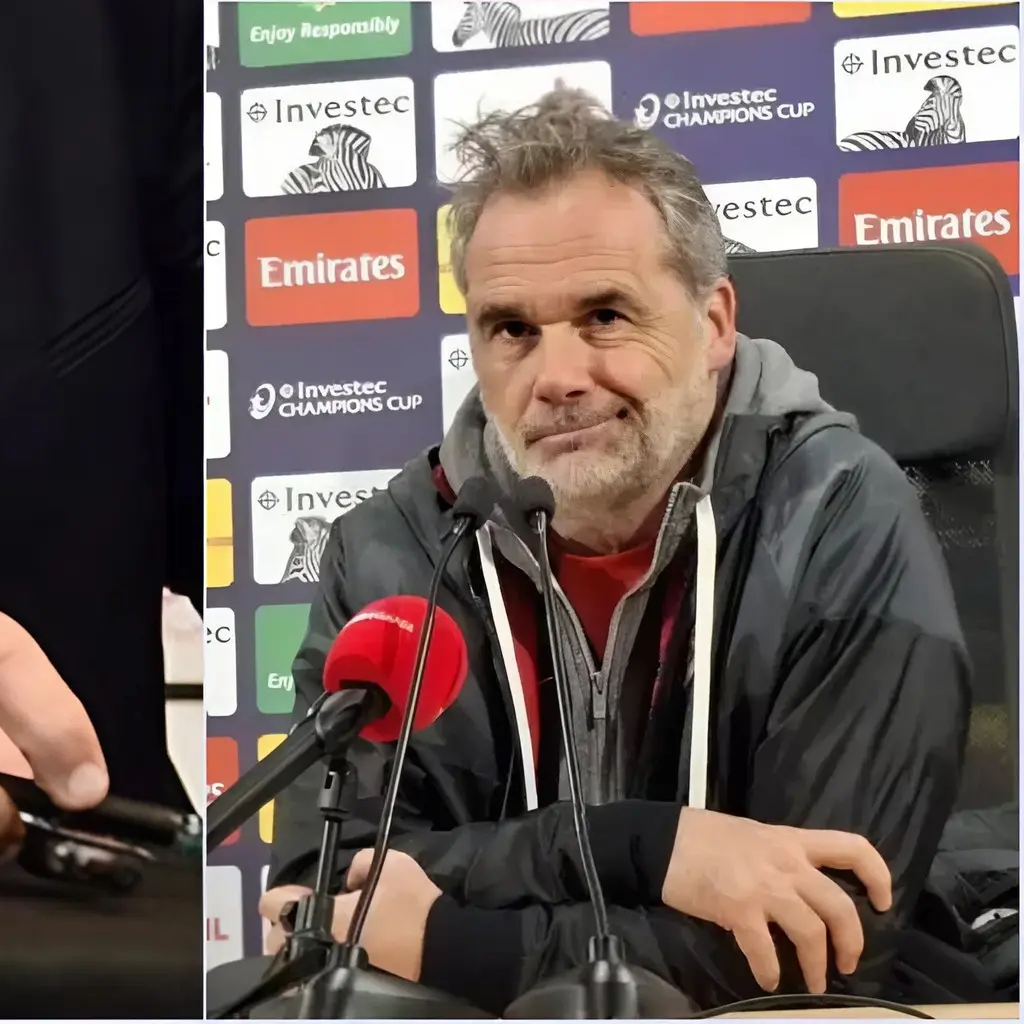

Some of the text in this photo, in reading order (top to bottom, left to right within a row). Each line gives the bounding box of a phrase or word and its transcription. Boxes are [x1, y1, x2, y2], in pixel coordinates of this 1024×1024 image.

[249, 26, 295, 44] Enjoy
[872, 44, 1016, 75] Investec
[276, 95, 410, 123] Investec
[683, 88, 777, 109] Investec
[663, 102, 815, 128] CHAMPIONS CUP
[714, 196, 812, 220] estec
[854, 208, 1011, 246] Emirates
[257, 252, 405, 288] Emirates
[298, 381, 387, 399] Investec
[279, 394, 423, 417] CHAMPIONS CUP
[285, 486, 376, 512] Inves
[267, 672, 294, 692] Enj
